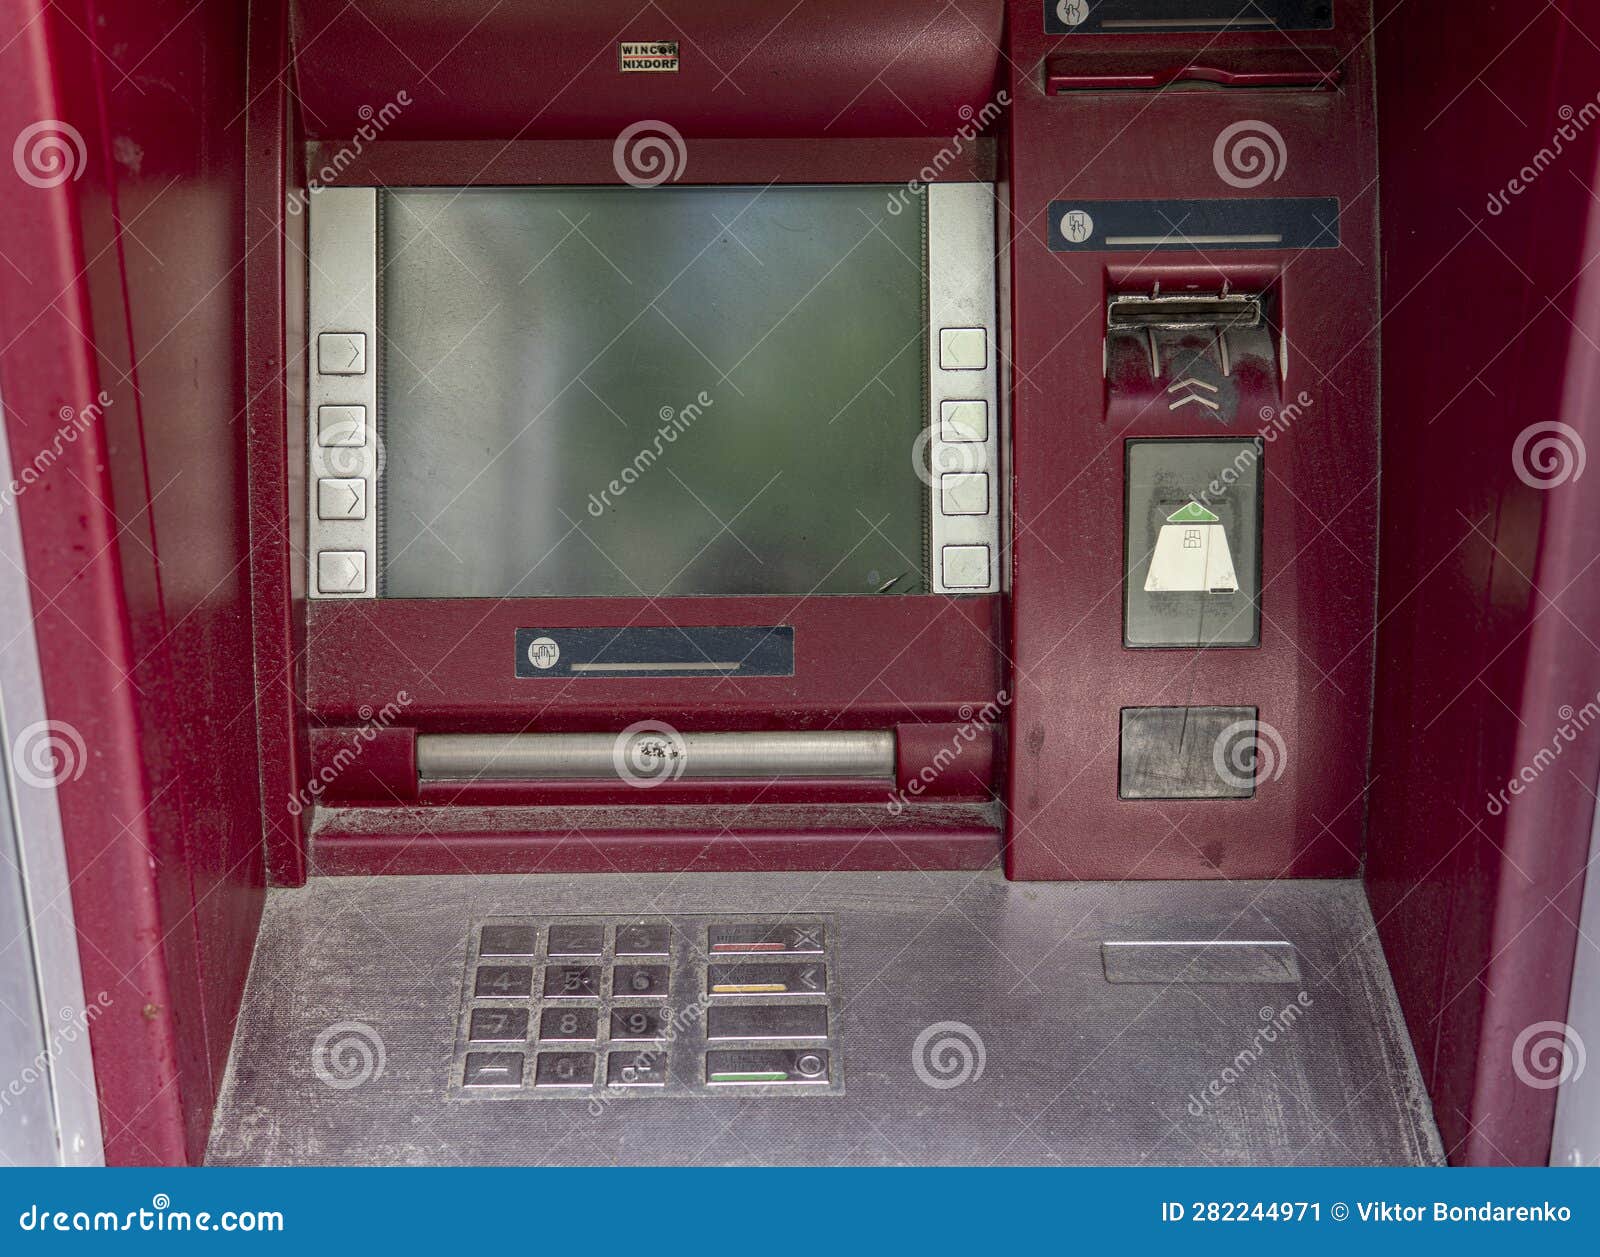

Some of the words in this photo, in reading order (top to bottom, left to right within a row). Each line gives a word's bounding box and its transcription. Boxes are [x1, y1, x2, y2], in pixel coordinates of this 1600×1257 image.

[622, 45, 677, 55] WINCOR
[623, 59, 677, 69] NIXDORF
[493, 971, 511, 990] 4
[564, 971, 581, 990] 5
[632, 971, 650, 990] 6
[490, 1014, 508, 1034] 7
[560, 1013, 578, 1034] 8
[629, 1013, 648, 1034] 9
